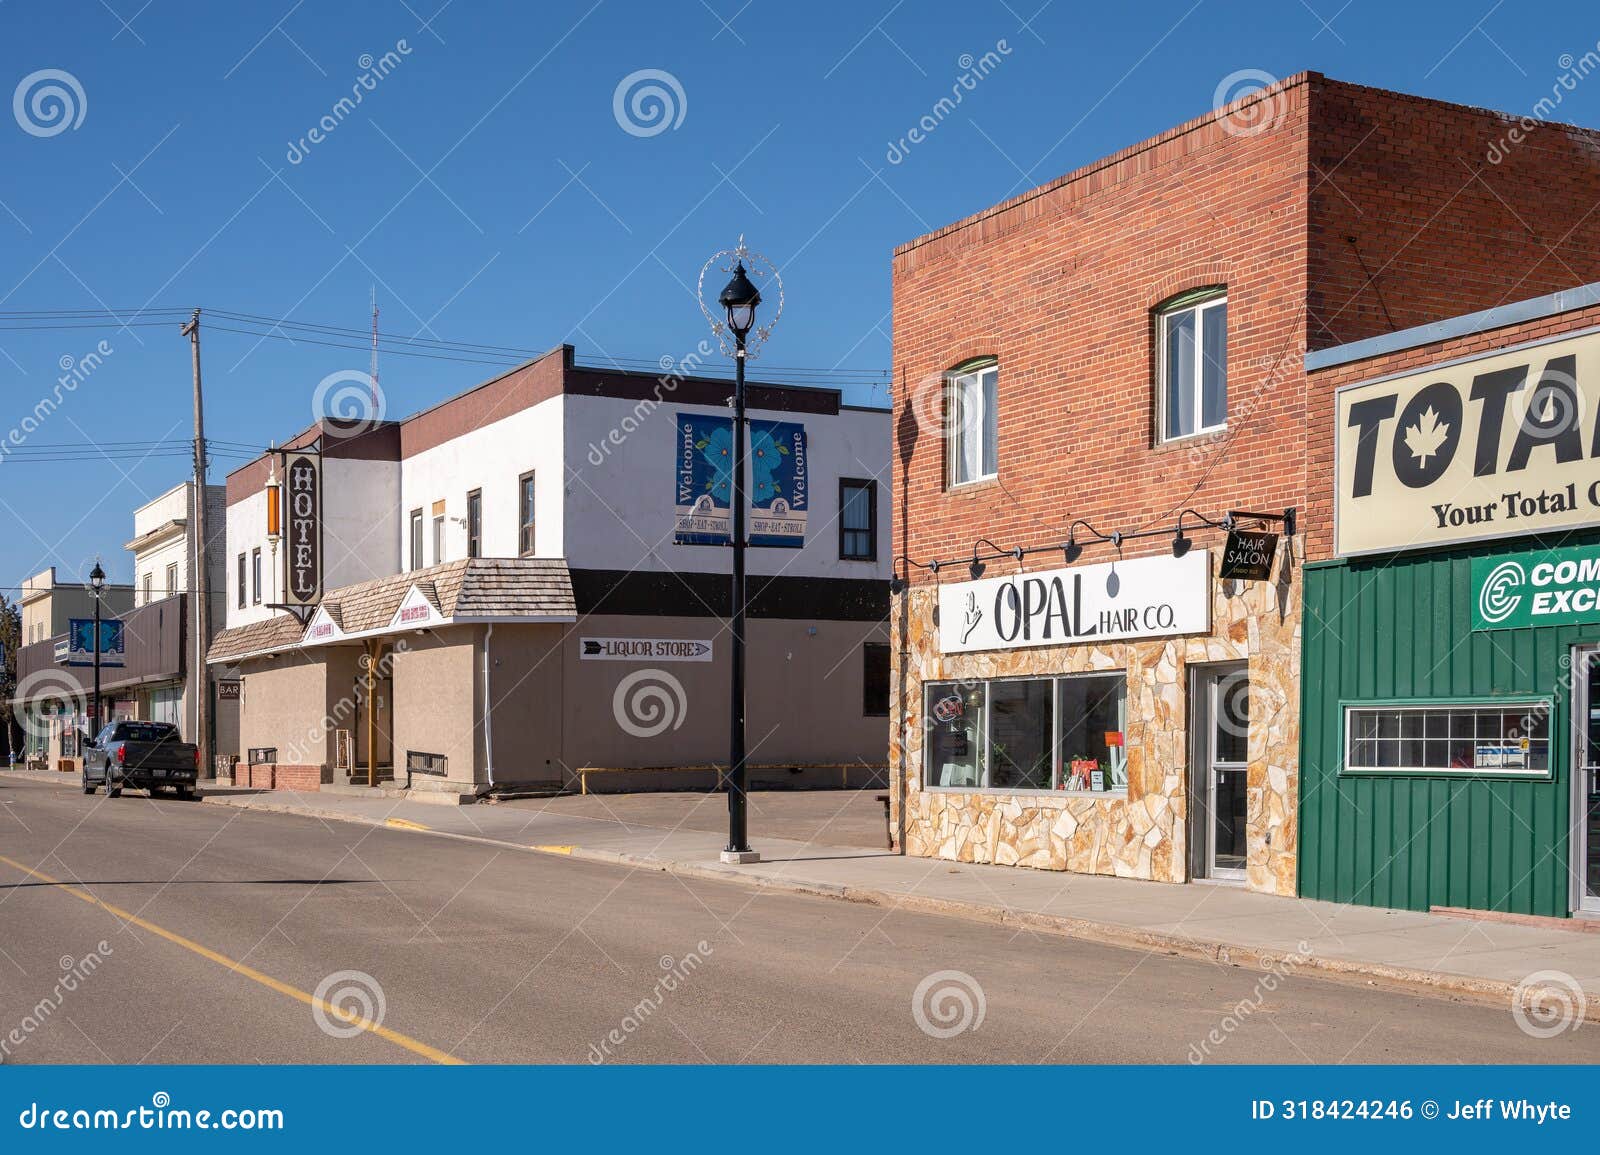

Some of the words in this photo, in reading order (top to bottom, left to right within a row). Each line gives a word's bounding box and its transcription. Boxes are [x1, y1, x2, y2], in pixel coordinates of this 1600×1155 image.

[1348, 354, 1600, 498] TOTA
[680, 423, 693, 503] Welcome
[793, 432, 805, 508] Welcome
[1432, 501, 1497, 529] Your
[1501, 483, 1578, 519] Total
[293, 467, 314, 593] HOTEL
[1238, 538, 1265, 551] HAIR
[1227, 550, 1270, 565] SALON
[994, 573, 1097, 642] OPAL
[1100, 608, 1138, 634] HAIR
[1143, 604, 1177, 630] CO.
[1531, 587, 1600, 615] EXC
[606, 641, 653, 657] LIQUOR
[656, 642, 694, 657] STORE
[220, 685, 239, 694] BAR
